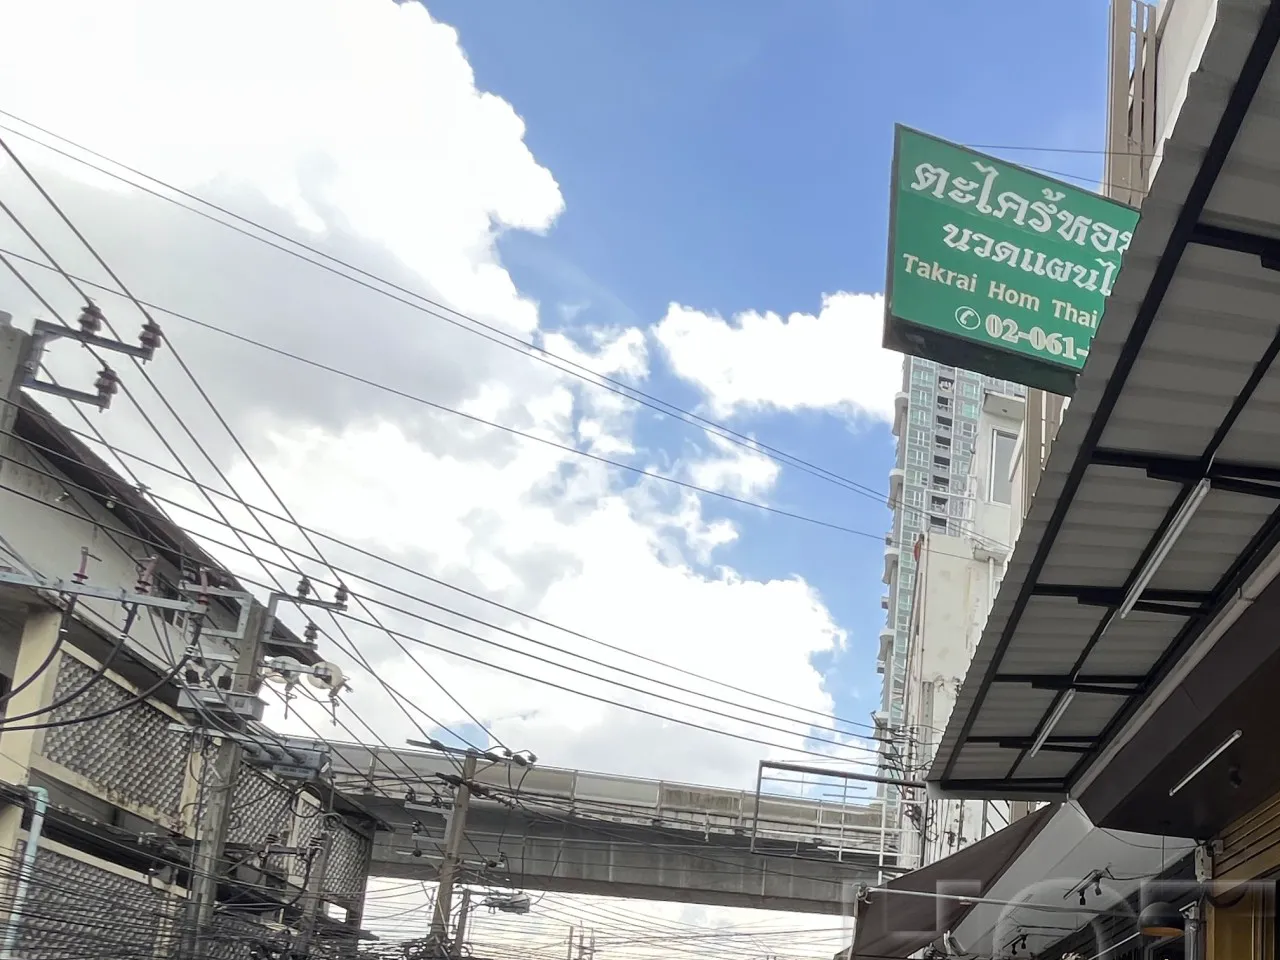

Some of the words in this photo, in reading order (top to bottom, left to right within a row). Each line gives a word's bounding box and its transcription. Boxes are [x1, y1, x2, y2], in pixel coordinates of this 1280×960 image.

[903, 253, 977, 293] Takrai
[988, 281, 1040, 312] Hom
[1052, 300, 1098, 329] Thai
[985, 314, 1090, 361] 02-061-
